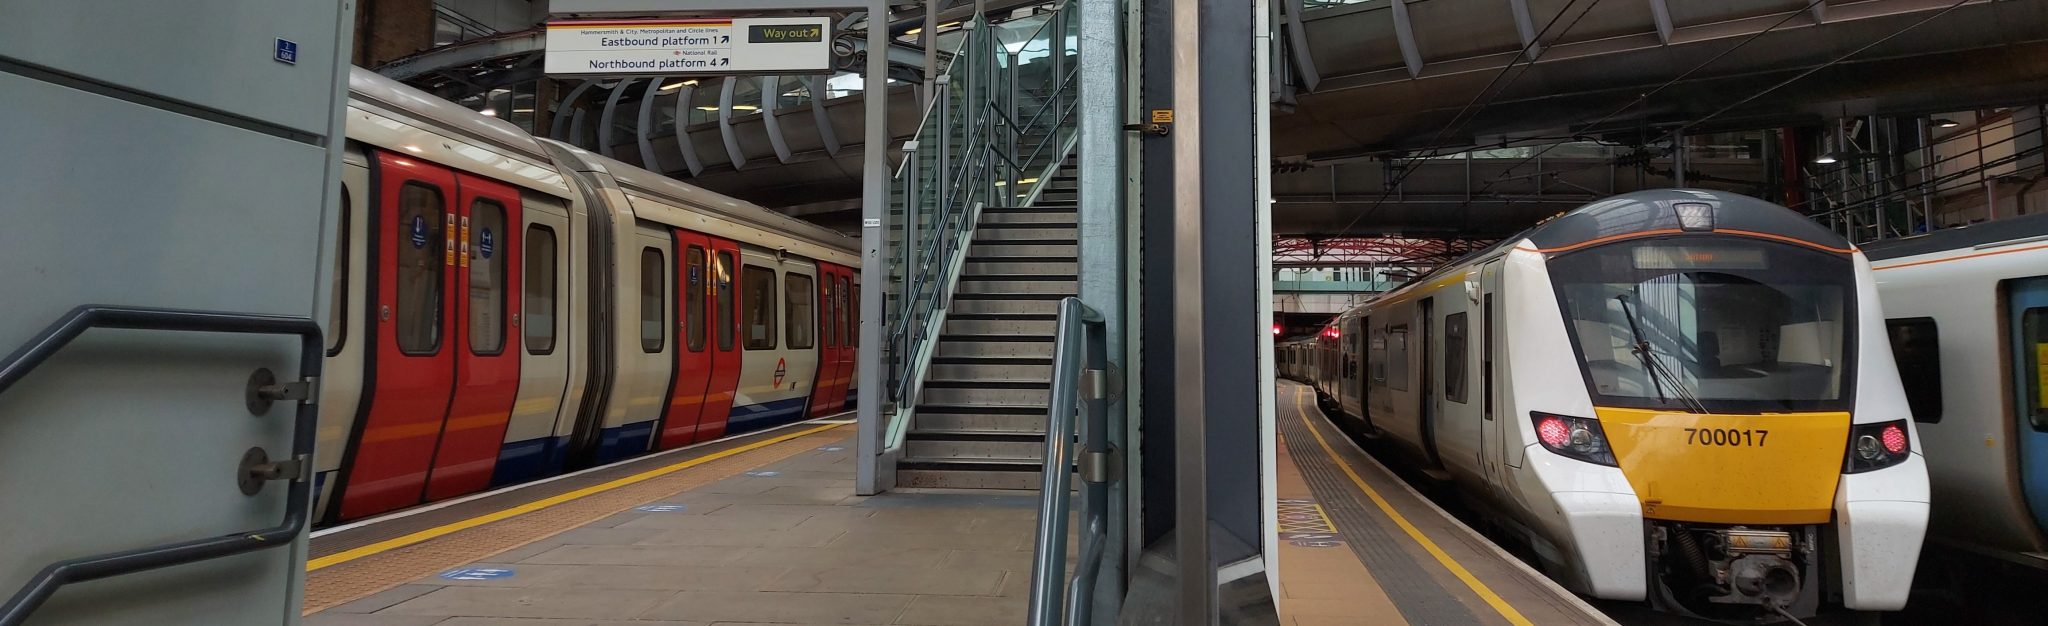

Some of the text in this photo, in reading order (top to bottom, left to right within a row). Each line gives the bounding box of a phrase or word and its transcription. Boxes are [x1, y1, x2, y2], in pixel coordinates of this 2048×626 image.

[763, 28, 808, 39] Way out
[601, 36, 717, 47] Eastbound platform 1
[589, 58, 717, 70] Northbound platform 4
[1684, 428, 1768, 447] 700017
